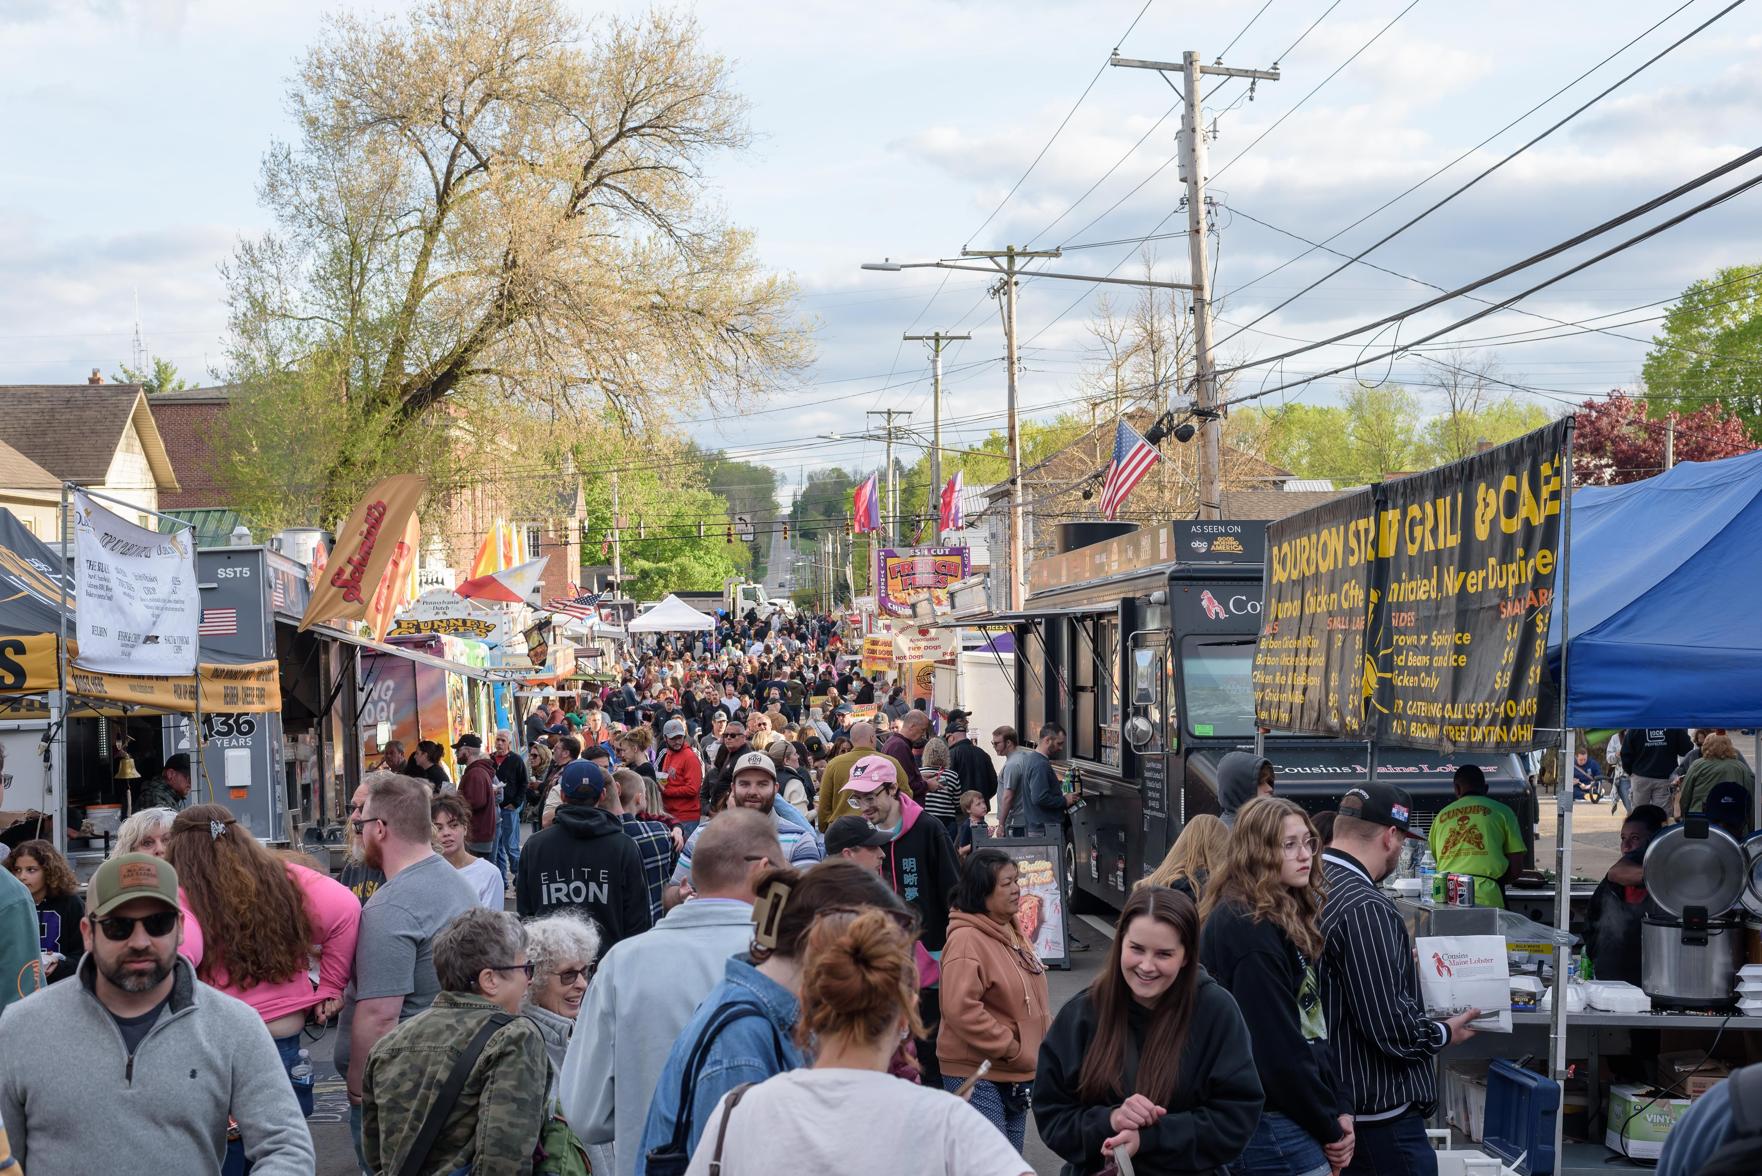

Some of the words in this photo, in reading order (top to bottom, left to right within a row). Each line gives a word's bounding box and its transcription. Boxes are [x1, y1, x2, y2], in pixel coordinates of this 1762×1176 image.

[1190, 525, 1202, 533] AS
[1203, 525, 1225, 533] SEEN
[1226, 525, 1242, 533] ON
[1272, 525, 1344, 585] BOURBON
[1348, 508, 1400, 568] STRT
[1474, 482, 1497, 541] &
[930, 548, 951, 556] CUT
[1190, 540, 1209, 549] abc
[1210, 544, 1244, 552] AMERICA
[217, 567, 250, 578] SST5
[889, 559, 961, 580] FRENCH
[900, 574, 949, 592] FRIES
[1341, 579, 1364, 609] Ofte
[1443, 565, 1487, 597] Nver
[422, 599, 460, 607] Pennsylvania
[1500, 597, 1525, 620] SMAL
[396, 618, 497, 634] FUNNEL
[1392, 634, 1418, 647] rown
[1407, 650, 1431, 667] Beans
[1392, 670, 1419, 687] icken
[1420, 671, 1440, 693] Only
[1464, 703, 1476, 719] US
[1511, 723, 1535, 742] OHI
[215, 738, 252, 748] YEARS
[1272, 764, 1353, 774] Cousins
[1421, 763, 1499, 775] Lober
[540, 867, 609, 884] ELITE
[541, 880, 609, 905] IRON
[1448, 959, 1469, 967] Maine
[1469, 957, 1494, 965] Lobster
